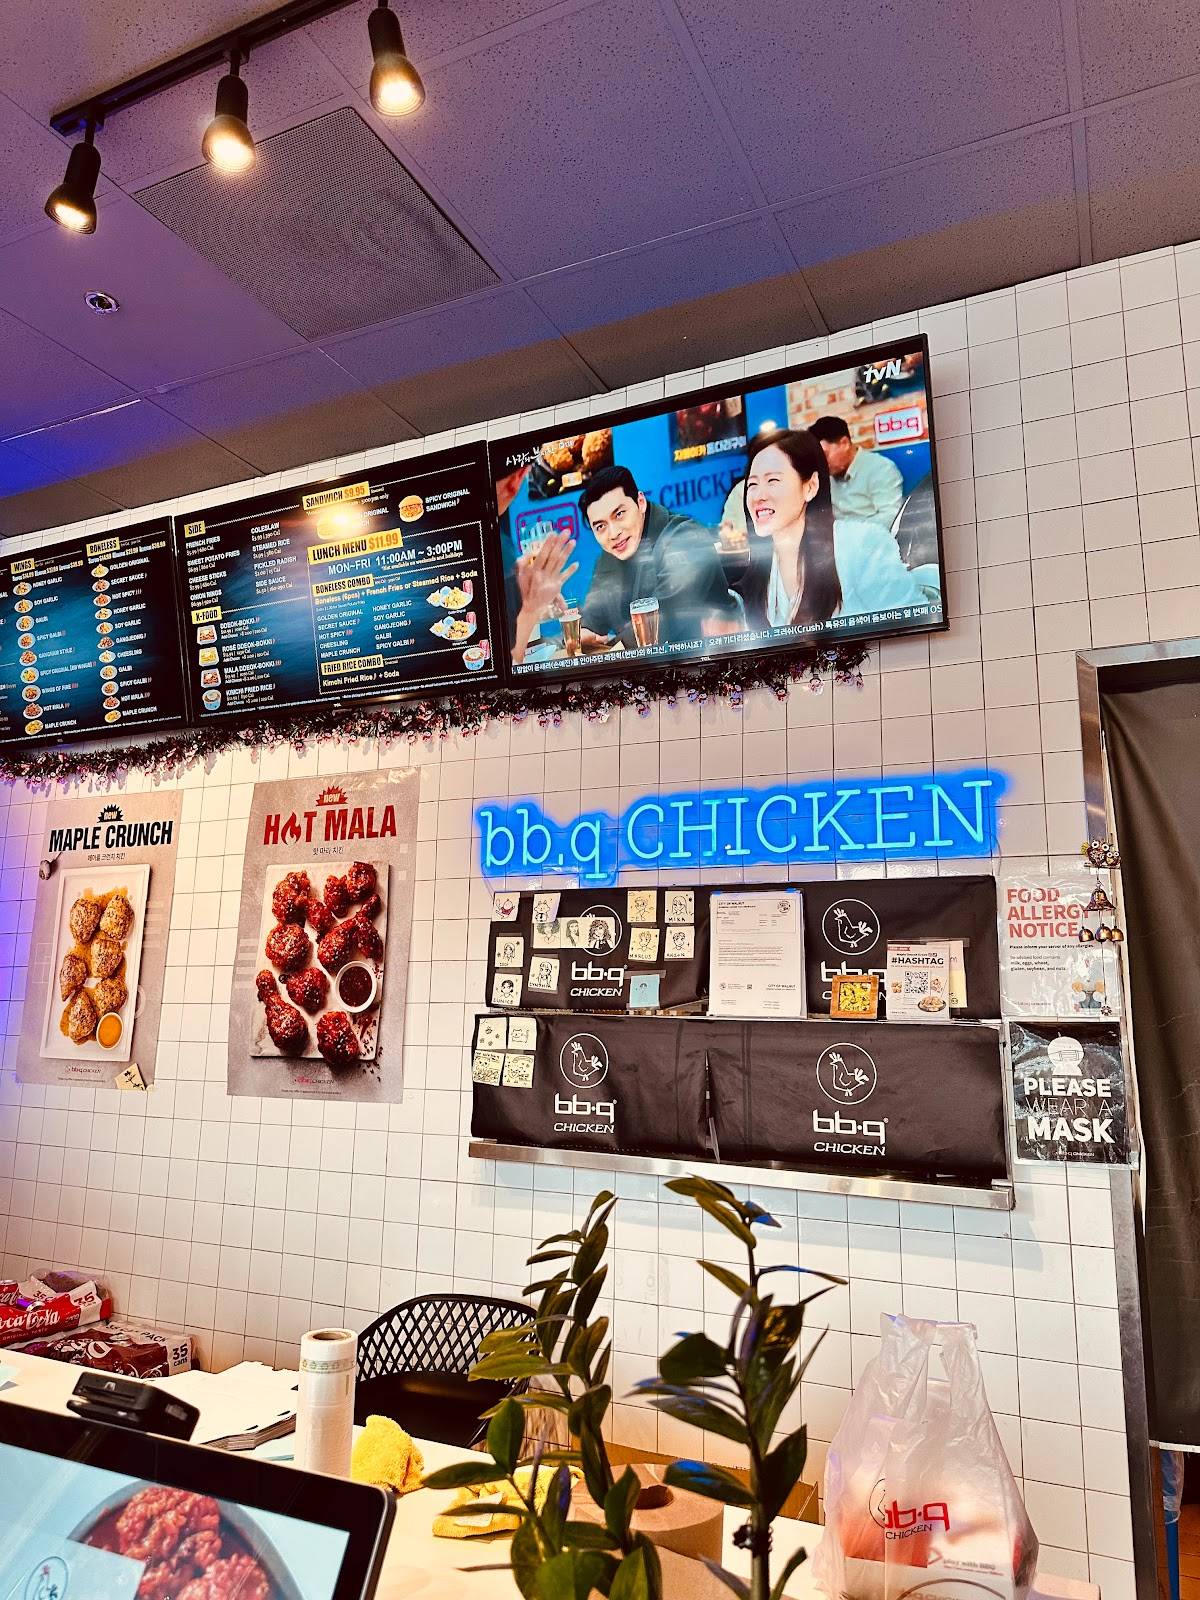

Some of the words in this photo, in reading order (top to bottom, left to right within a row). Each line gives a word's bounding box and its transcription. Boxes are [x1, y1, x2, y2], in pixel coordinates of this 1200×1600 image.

[864, 360, 902, 383] tvN
[306, 491, 343, 508] SANDWICH
[344, 485, 365, 499] $9.95
[425, 495, 441, 504] SPICY
[442, 488, 470, 500] ORIGINAL
[426, 500, 457, 513] SANDWICH
[188, 524, 202, 535] SIDE
[250, 522, 280, 534] COLESLAW
[90, 539, 117, 554] BONELESS
[185, 540, 206, 549] FRENCH
[206, 536, 220, 545] FRIES
[252, 541, 277, 552] STEAMED
[277, 539, 291, 547] RICE
[312, 545, 341, 561] LUNCH
[342, 539, 367, 556] MENU
[368, 532, 399, 550] $11.99
[187, 558, 205, 566] SWEET
[205, 553, 225, 562] POTATO
[225, 549, 240, 558] FRIES
[376, 549, 416, 566] 11:00AM
[426, 540, 463, 556] 3:00PM
[13, 560, 32, 573] WINGS
[254, 560, 277, 570] PICKLED
[277, 555, 297, 565] RADISH
[110, 576, 128, 585] SECRET
[128, 572, 144, 581] SAUCE
[188, 575, 209, 584] CHEESE
[209, 570, 227, 580] STICKS
[255, 579, 268, 588] SIDE
[268, 575, 287, 585] SAUCE
[314, 596, 342, 605] Boneless
[366, 587, 387, 596] French
[387, 584, 404, 593] Fries
[412, 577, 440, 587] Steamed
[440, 573, 454, 582] Rice
[461, 569, 478, 579] Soda
[315, 581, 347, 594] BONELESS
[347, 576, 371, 589] COMBO
[121, 589, 135, 598] SPICY
[190, 592, 207, 601] ONION
[206, 589, 222, 598] RINGS
[113, 606, 128, 614] HONEY
[128, 602, 146, 612] GARLIC
[372, 604, 392, 612] HONEY
[392, 600, 412, 609] GARLIC
[195, 610, 218, 621] K-FOOD
[316, 613, 338, 622] GOLDEN
[338, 608, 363, 618] ORIGINAL
[373, 614, 385, 622] SOY
[385, 611, 406, 619] GARLIC
[114, 621, 124, 629] SOY
[124, 619, 141, 627] GARLIC
[317, 622, 338, 631] SECRET
[338, 619, 357, 628] SAUCE
[318, 633, 330, 641] HOT
[331, 630, 346, 638] SPICY
[375, 632, 391, 641] GALBI
[319, 640, 348, 650] CHEESLING
[375, 642, 393, 650] SPICY
[393, 639, 409, 647] GALBI
[320, 650, 339, 658] MAPLE
[339, 647, 361, 656] CRUNCH
[224, 665, 239, 674] MALA
[323, 663, 341, 673] FRIED
[342, 661, 357, 670] RICE
[357, 656, 382, 668] COMBO
[322, 676, 343, 687] Kimchi
[343, 673, 359, 684] Fried
[359, 672, 374, 682] Rice
[384, 670, 400, 679] Soda
[323, 792, 341, 803] new
[103, 811, 117, 820] new
[627, 779, 993, 860] CHICKEN
[263, 810, 317, 845] HOT
[324, 804, 397, 841] MALA
[48, 826, 102, 853] MAPLE
[105, 820, 173, 849] CRUNCH
[1007, 887, 1060, 904] FOOD
[1007, 904, 1090, 921] ALLERGY
[1009, 922, 1080, 939] NOTICE
[891, 957, 944, 965] #HASHTAG
[570, 987, 623, 997] CHICKEN
[1023, 1077, 1112, 1098] PLEASE
[1025, 1097, 1088, 1117] WEAR
[1098, 1099, 1114, 1117] A
[553, 1122, 615, 1134] CHICKEN
[1026, 1115, 1116, 1144] MASK
[813, 1141, 886, 1156] CHICKEN
[172, 1343, 188, 1360] 35
[173, 1357, 188, 1367] cans
[885, 1523, 933, 1540] CHICKEN
